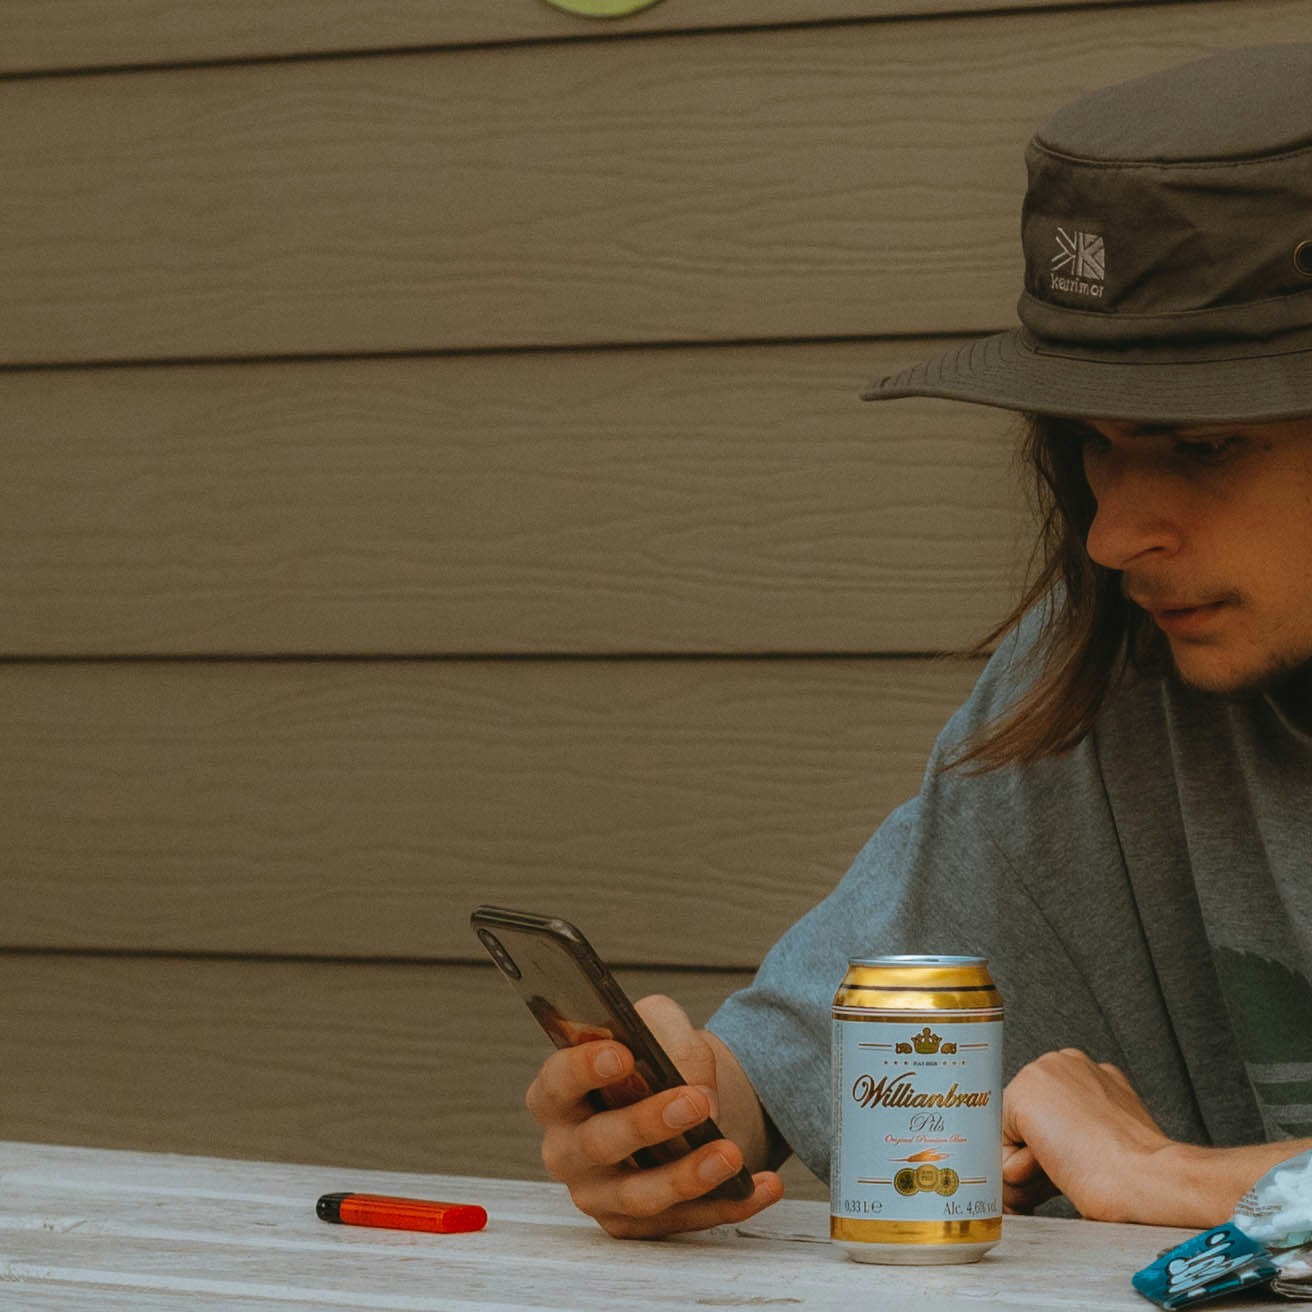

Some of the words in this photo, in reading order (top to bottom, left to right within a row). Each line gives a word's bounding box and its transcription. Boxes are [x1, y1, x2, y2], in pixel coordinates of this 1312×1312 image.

[1050, 272, 1104, 298] karrimor
[852, 1072, 989, 1109] Willianbrau
[909, 1112, 945, 1133] Pils
[944, 1201, 963, 1215] Alc.
